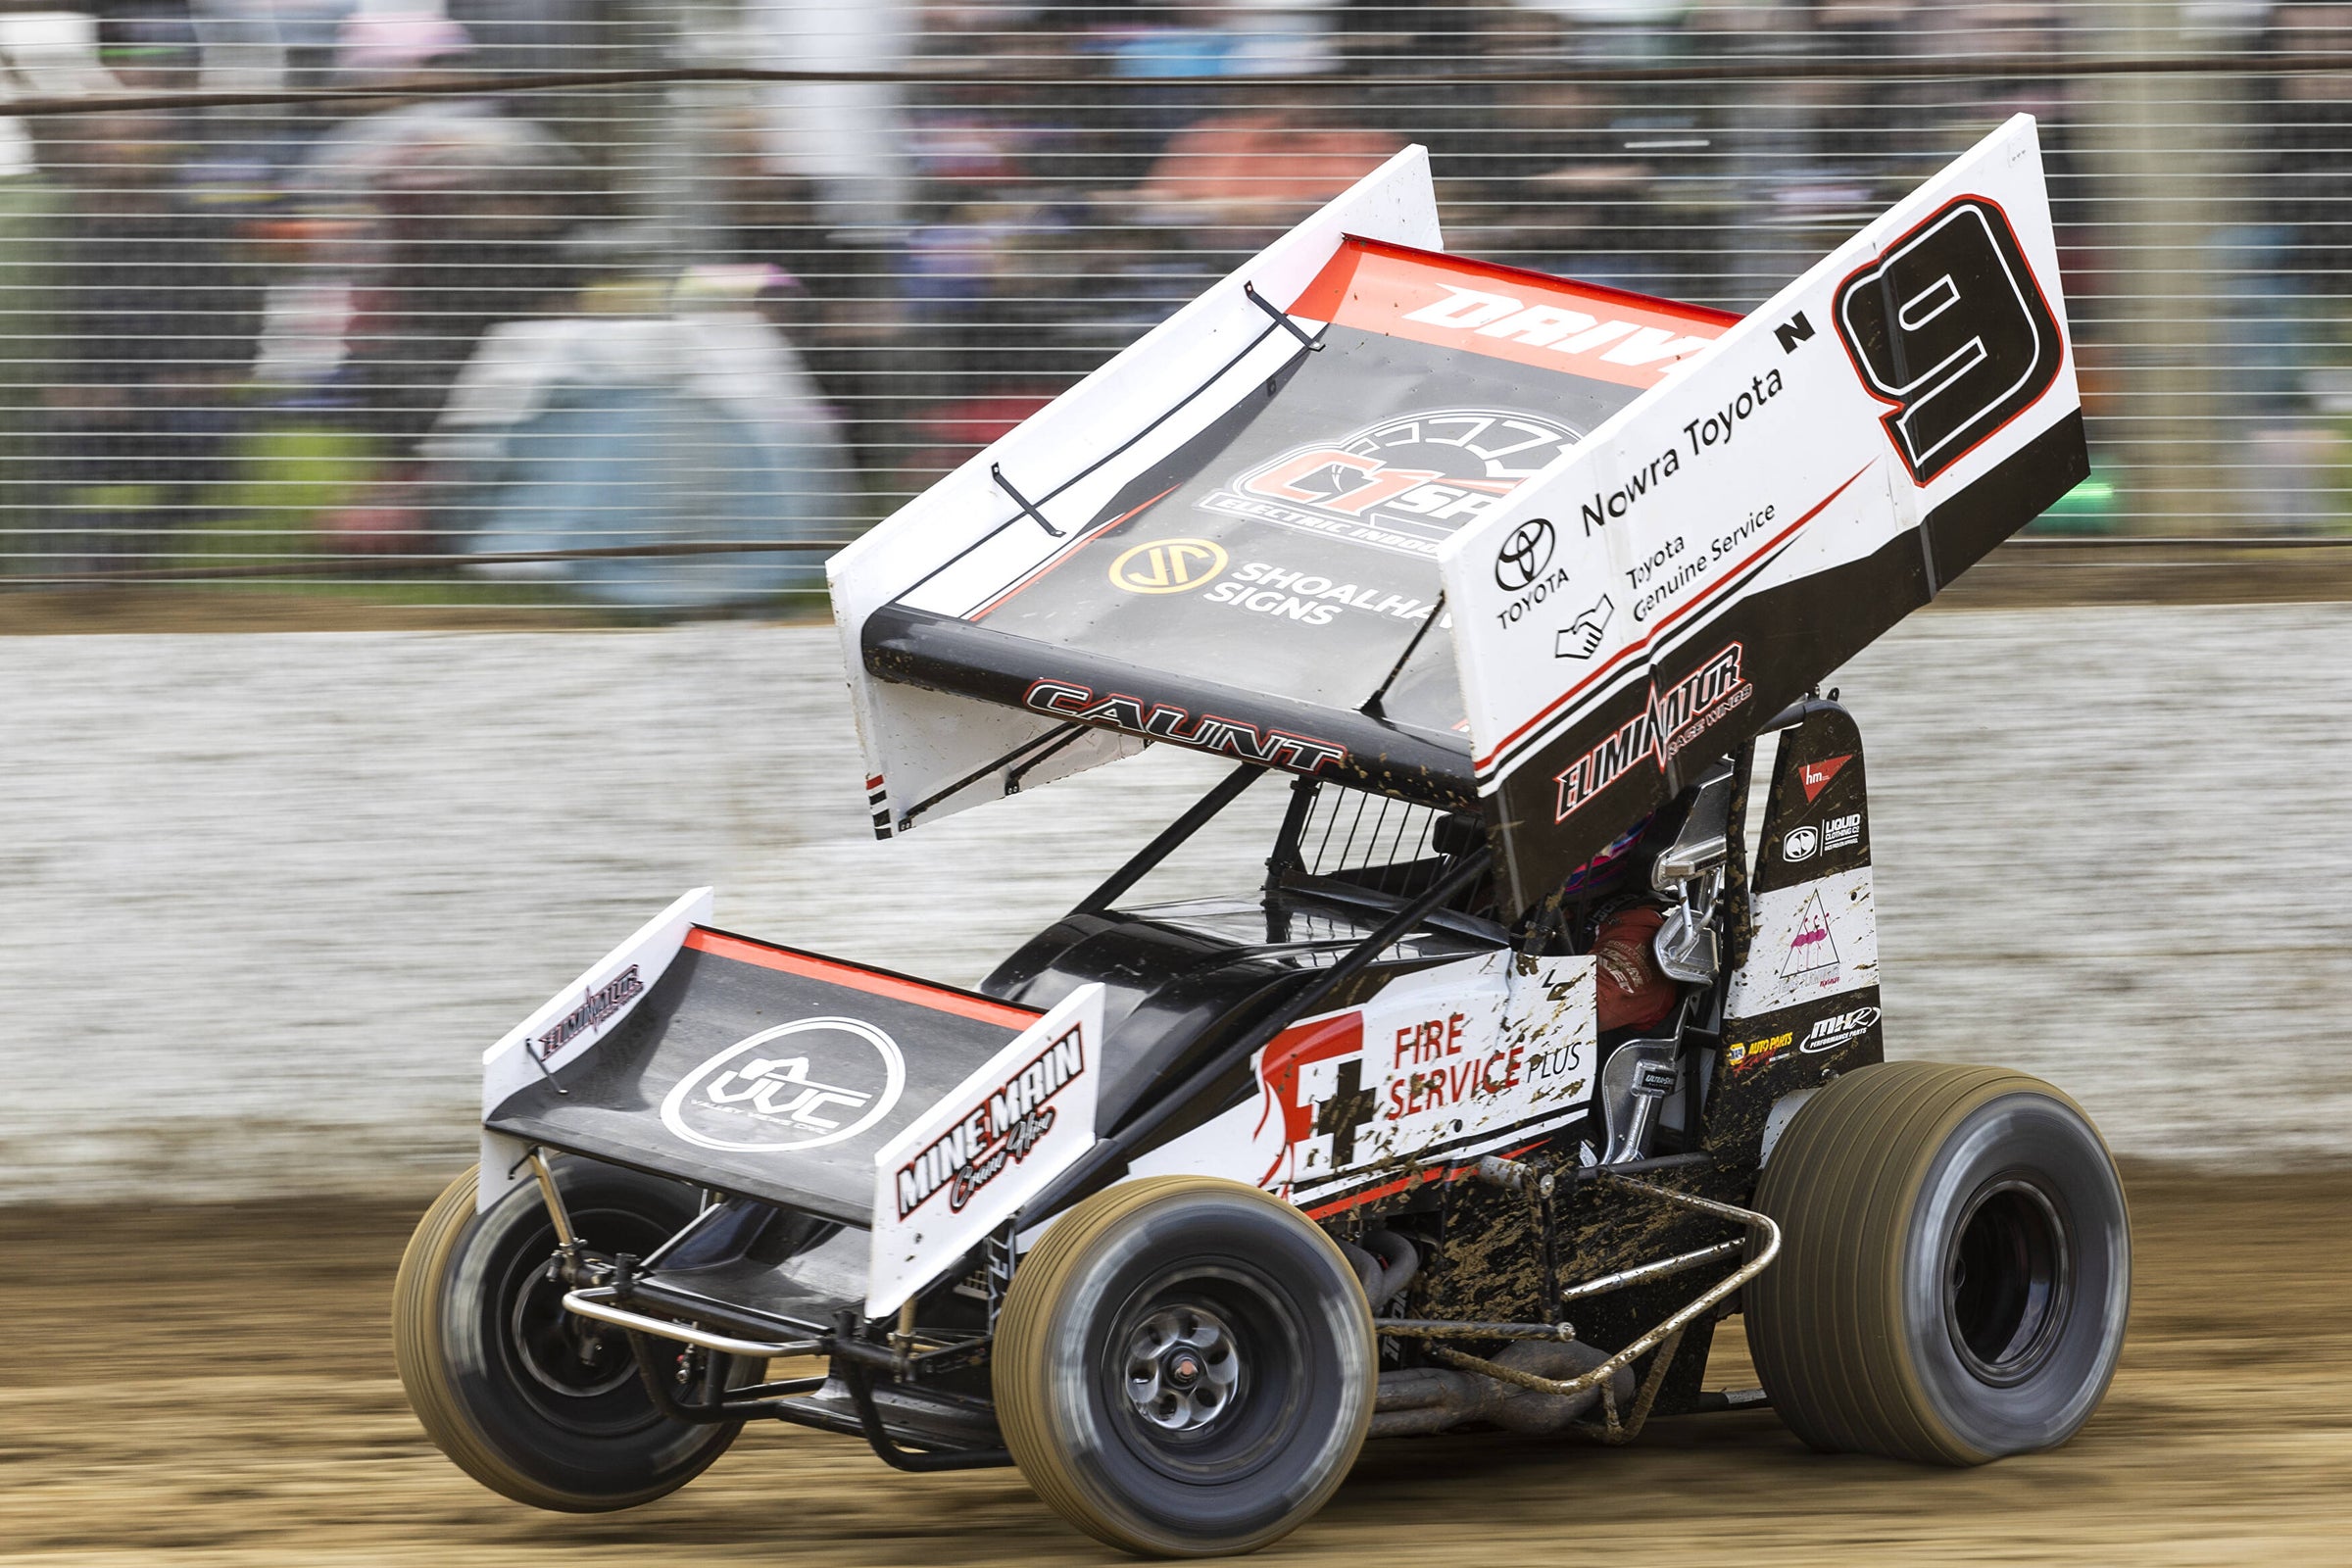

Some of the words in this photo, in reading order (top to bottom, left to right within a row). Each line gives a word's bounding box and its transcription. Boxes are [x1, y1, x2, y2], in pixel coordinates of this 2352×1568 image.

[1832, 193, 2063, 487] 9
[1581, 448, 1680, 537] Nowra
[1683, 368, 1783, 456] Toyota
[1216, 499, 1345, 535] ELECTRIC
[1625, 536, 1686, 589] Toyota
[1633, 555, 1707, 622] Genuine
[1711, 504, 1776, 562] Service
[1203, 581, 1343, 625] SIGNS
[1496, 567, 1570, 629] TOYOTA
[1024, 681, 1346, 773] CAUNT
[1552, 640, 1746, 824] ELIMINATOR
[1668, 719, 1706, 760] RACE
[1706, 683, 1752, 728] WINGS
[1825, 827, 1851, 841] CLOTHING
[1826, 813, 1860, 833] LIQUID
[1395, 1013, 1464, 1069] FIRE
[1748, 1039, 1769, 1055] AUTO
[1769, 1032, 1793, 1051] PARTS
[1810, 1033, 1849, 1049] PERFORMANCE
[1849, 1028, 1868, 1039] PARTS
[1387, 1046, 1524, 1121] SERVICE
[1527, 1042, 1582, 1083] PLUS
